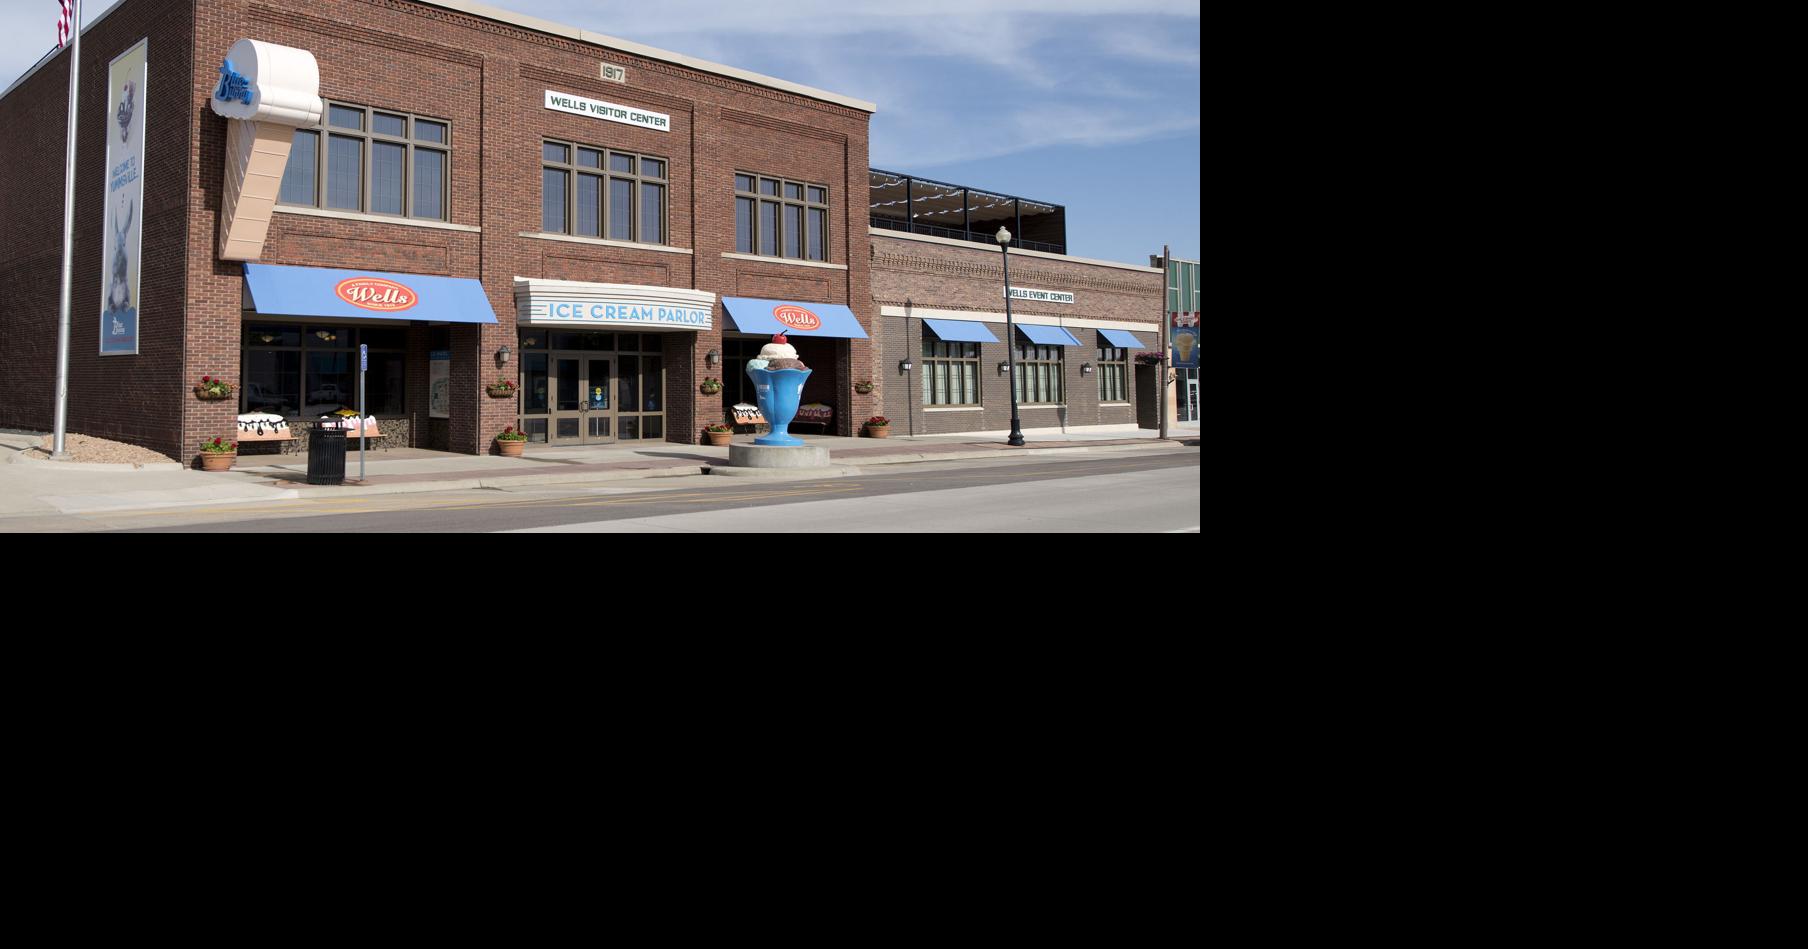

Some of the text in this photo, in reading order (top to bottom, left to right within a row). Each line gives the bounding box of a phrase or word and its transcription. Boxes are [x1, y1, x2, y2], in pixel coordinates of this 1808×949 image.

[602, 65, 624, 80] 1917
[550, 95, 667, 127] WELLS VISITOR CENTER
[346, 286, 408, 304] Wells
[1028, 290, 1049, 300] EVENT
[1050, 292, 1073, 302] CENTER
[548, 303, 705, 325] ICE CREAM PARLOR
[780, 311, 816, 325] Wells
